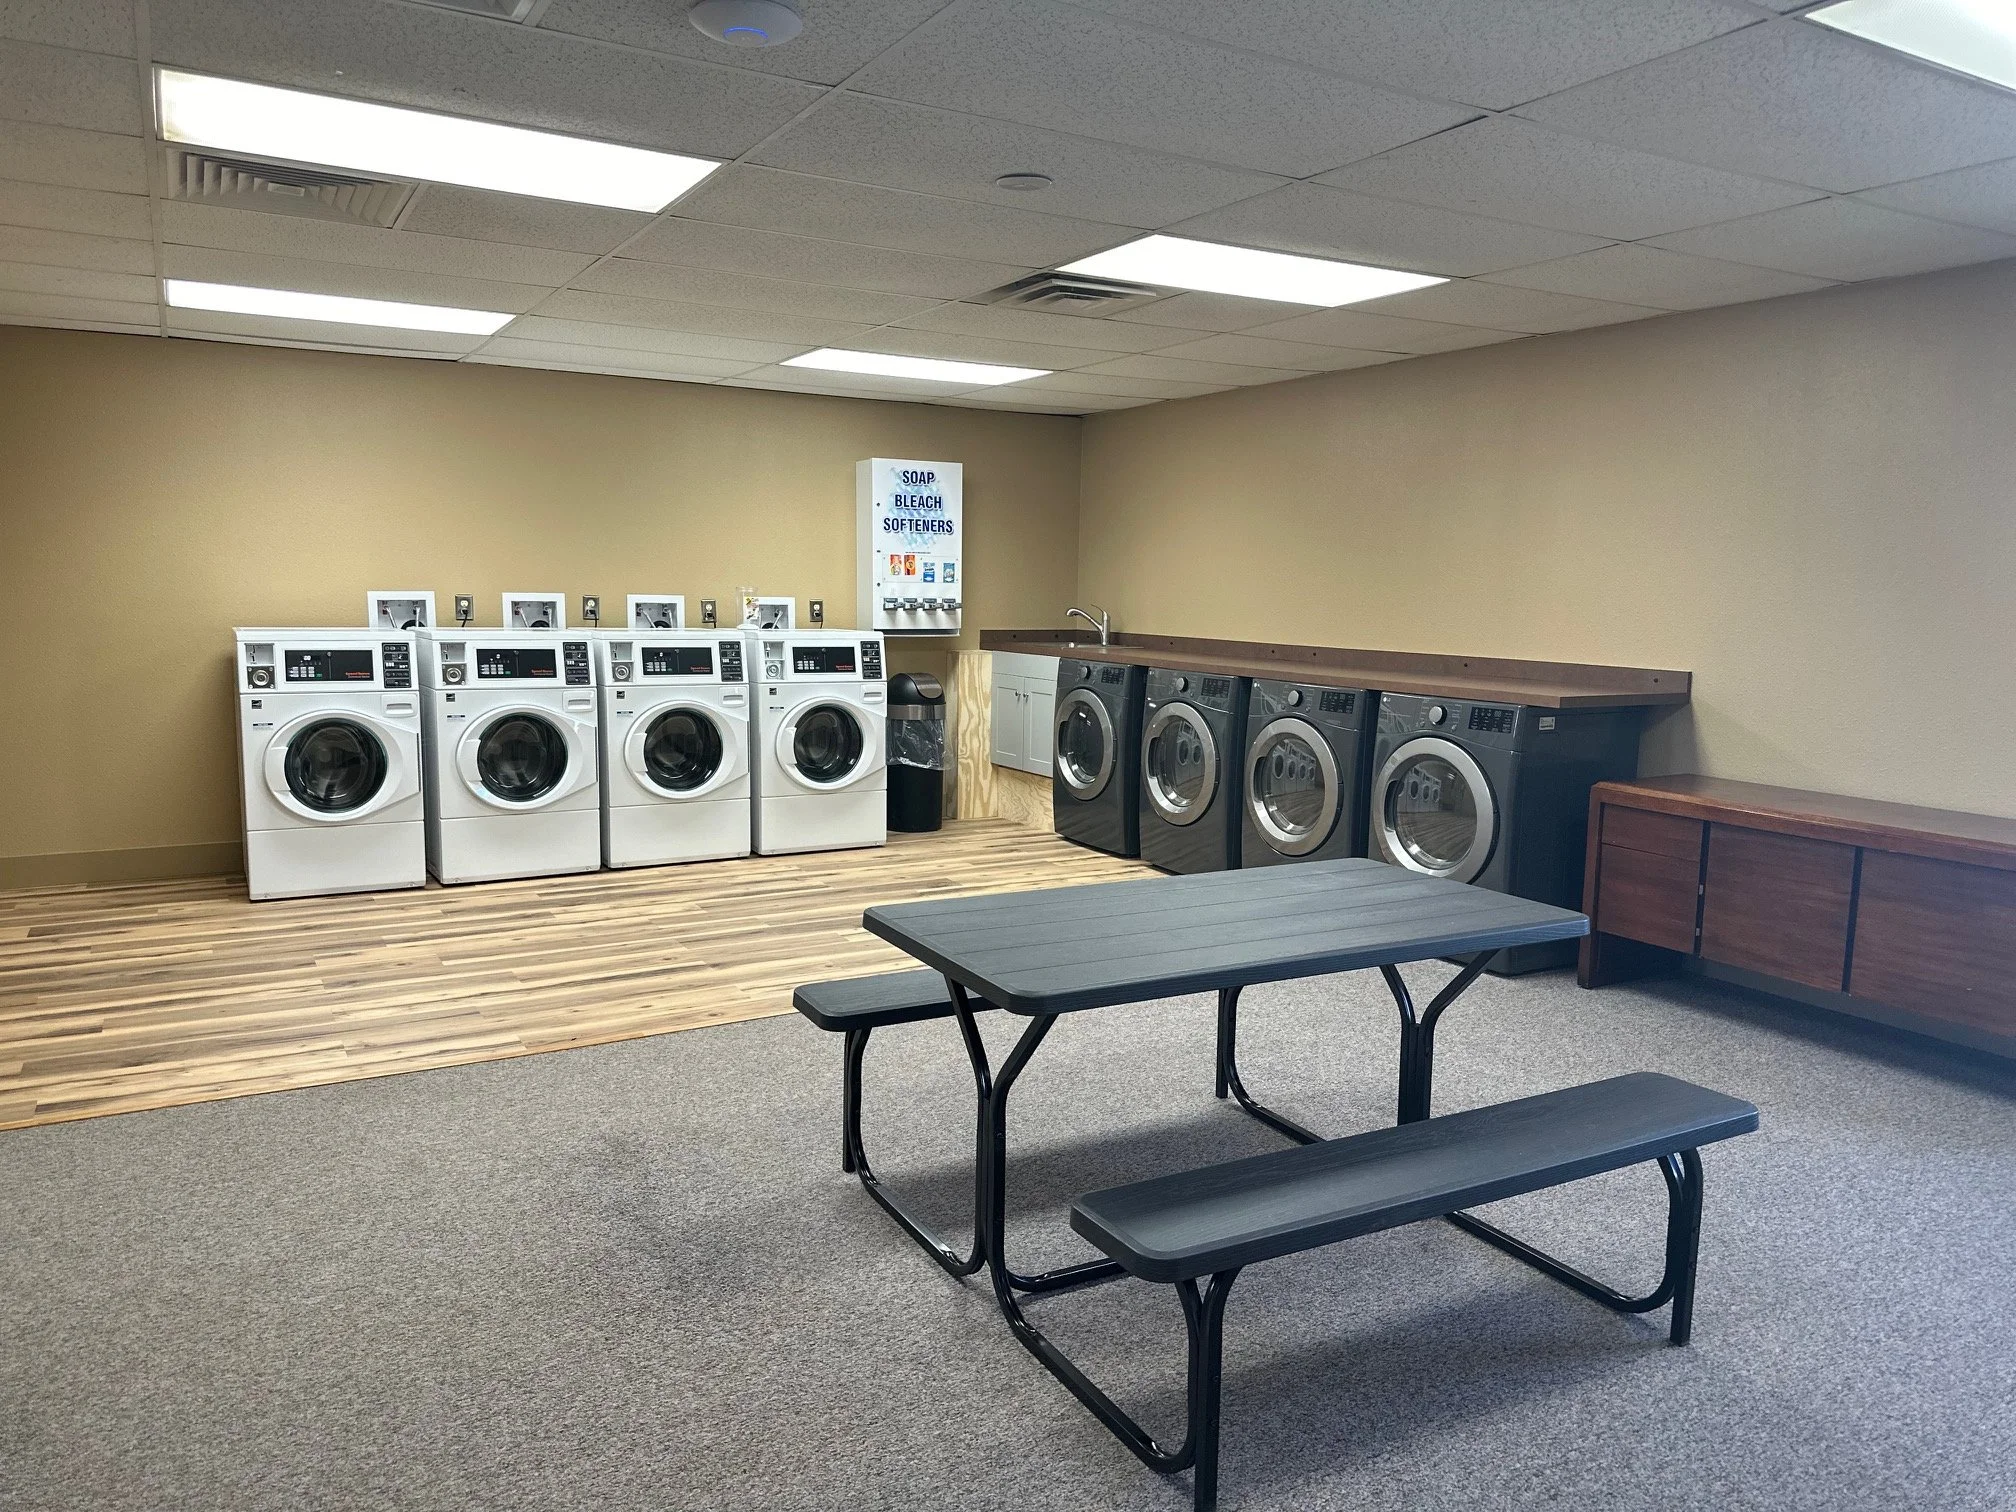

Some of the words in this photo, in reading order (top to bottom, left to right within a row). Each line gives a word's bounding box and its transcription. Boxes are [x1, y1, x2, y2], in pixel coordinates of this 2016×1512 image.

[902, 470, 935, 485] SOAP
[894, 494, 943, 509] BLEACH
[883, 517, 953, 533] SOFTENERS
